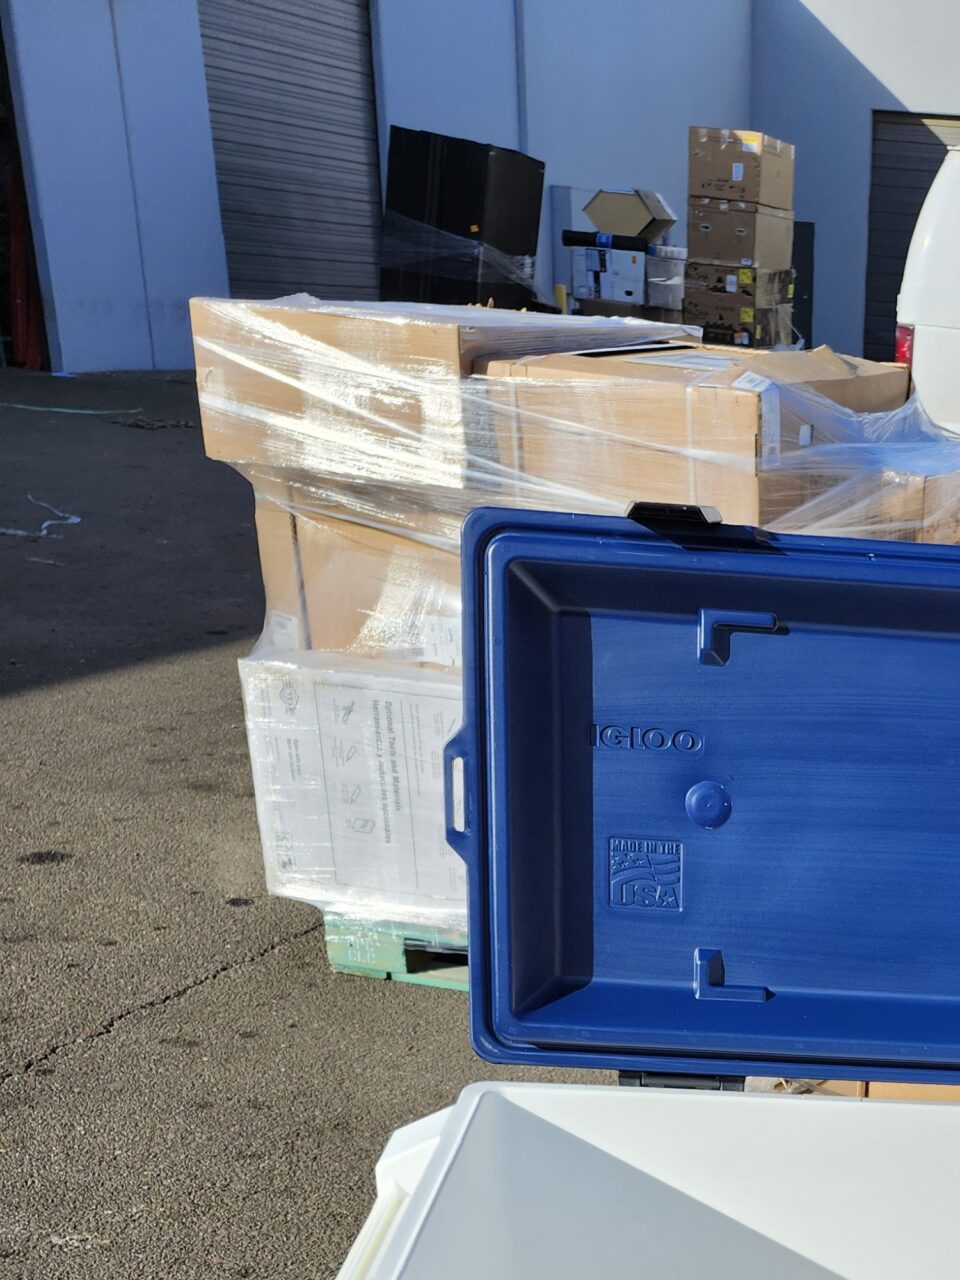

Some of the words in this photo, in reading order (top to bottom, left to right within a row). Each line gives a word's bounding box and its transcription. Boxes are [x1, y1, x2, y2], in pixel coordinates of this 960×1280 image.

[588, 723, 703, 751] IGLOO
[612, 839, 642, 853] MADE
[645, 841, 658, 854] IN
[660, 842, 681, 855] THE
[620, 884, 680, 908] USA
